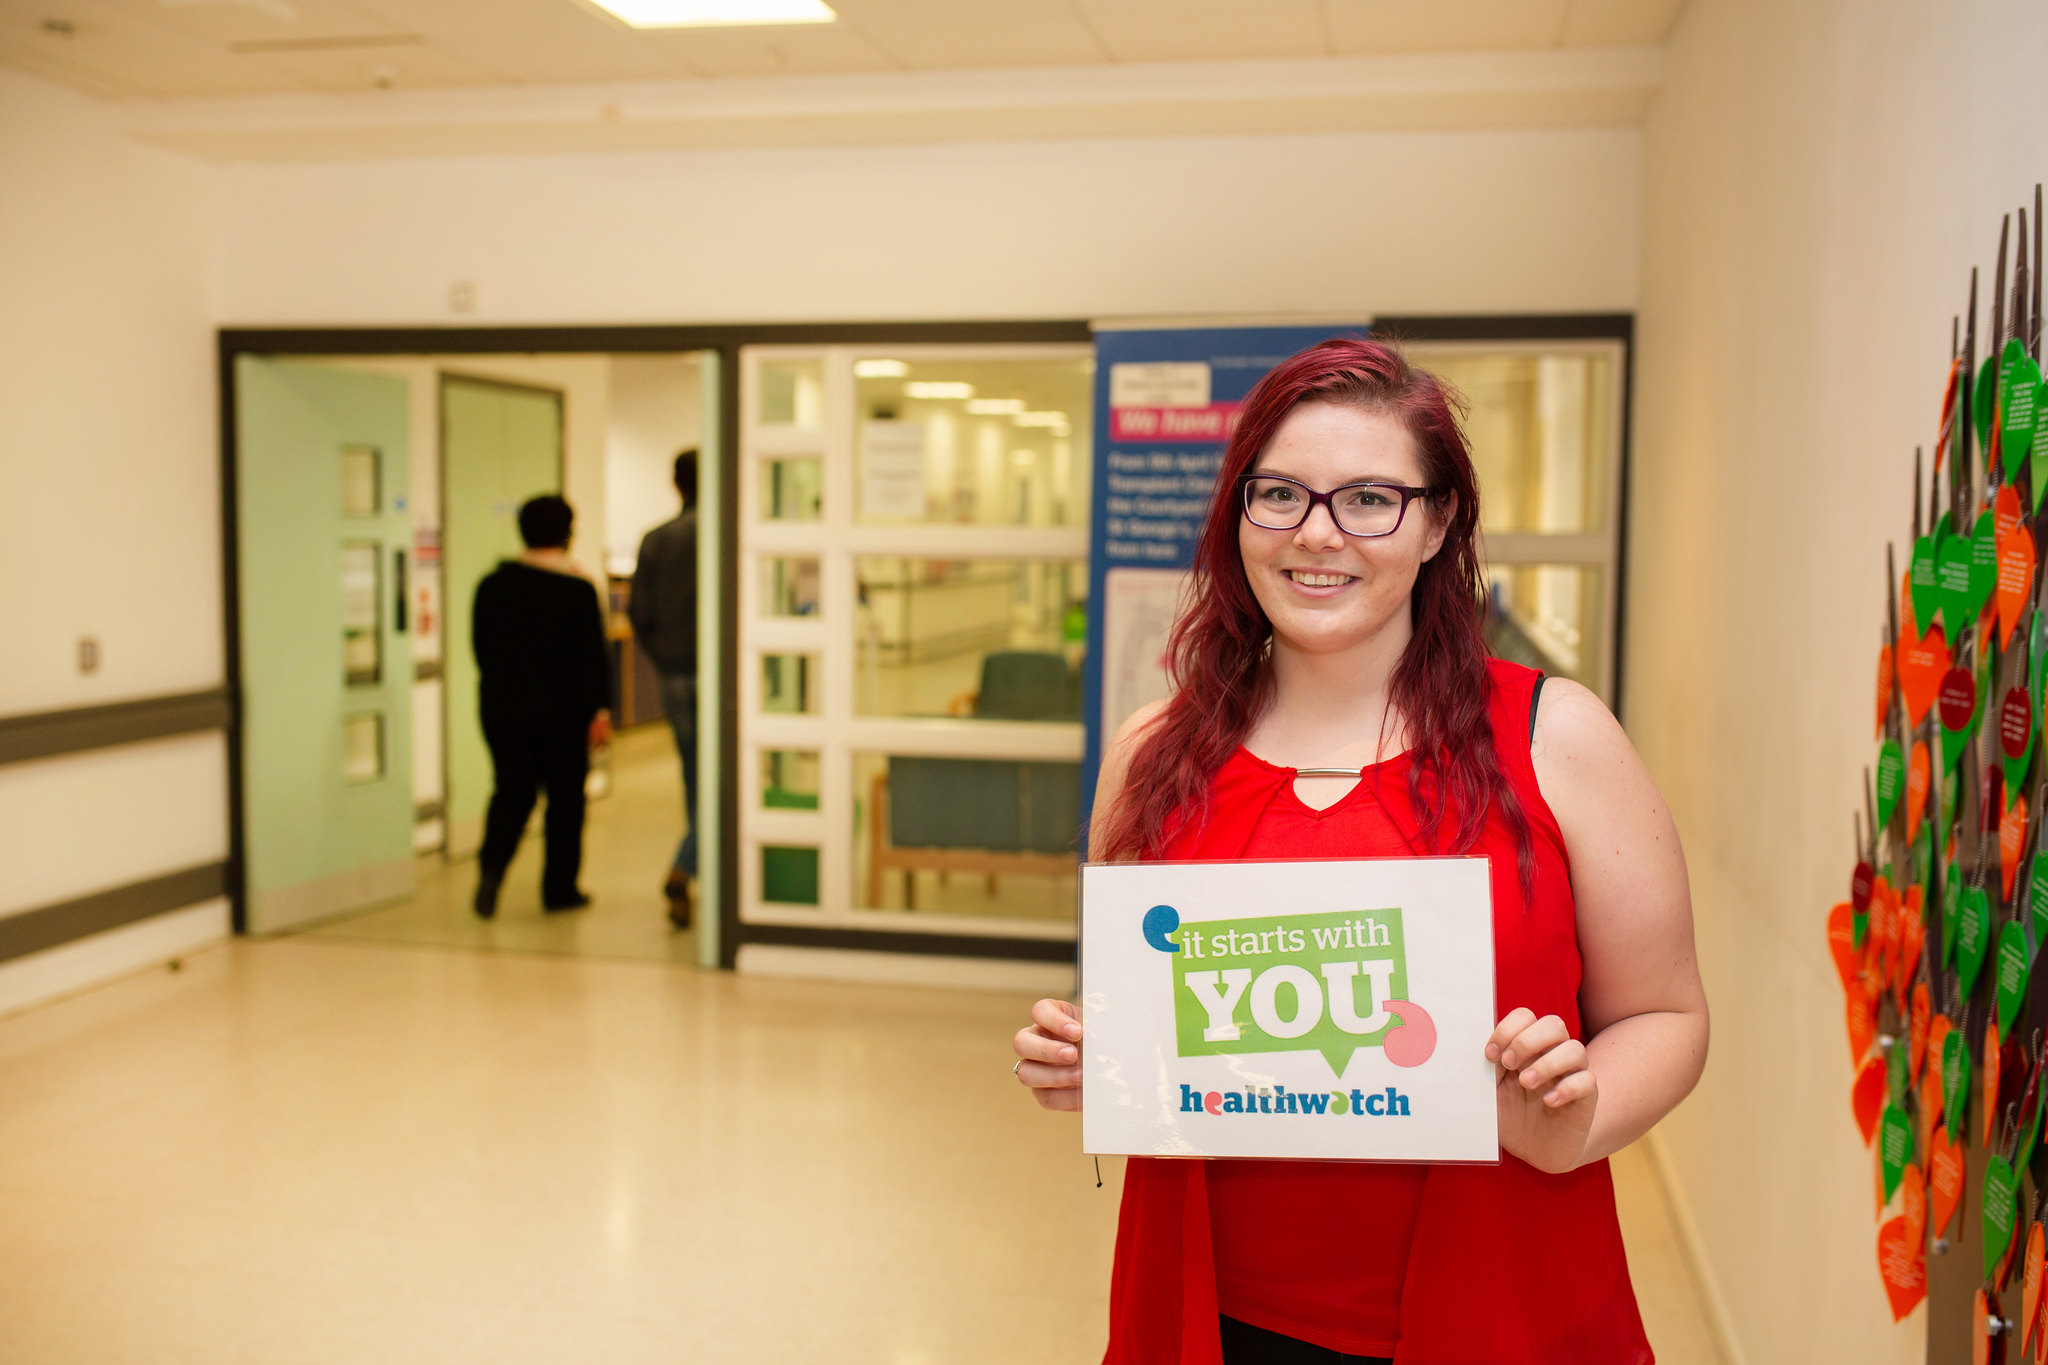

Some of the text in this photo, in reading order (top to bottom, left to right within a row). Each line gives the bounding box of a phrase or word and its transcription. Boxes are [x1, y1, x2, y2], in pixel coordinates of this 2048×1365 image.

[1118, 409, 1157, 434] We
[1161, 409, 1222, 434] have
[1108, 453, 1146, 470] From
[1176, 453, 1211, 472] April
[1182, 918, 1391, 959] it starts with
[1184, 959, 1394, 1042] YOU
[1179, 1084, 1411, 1117] healthwatch
